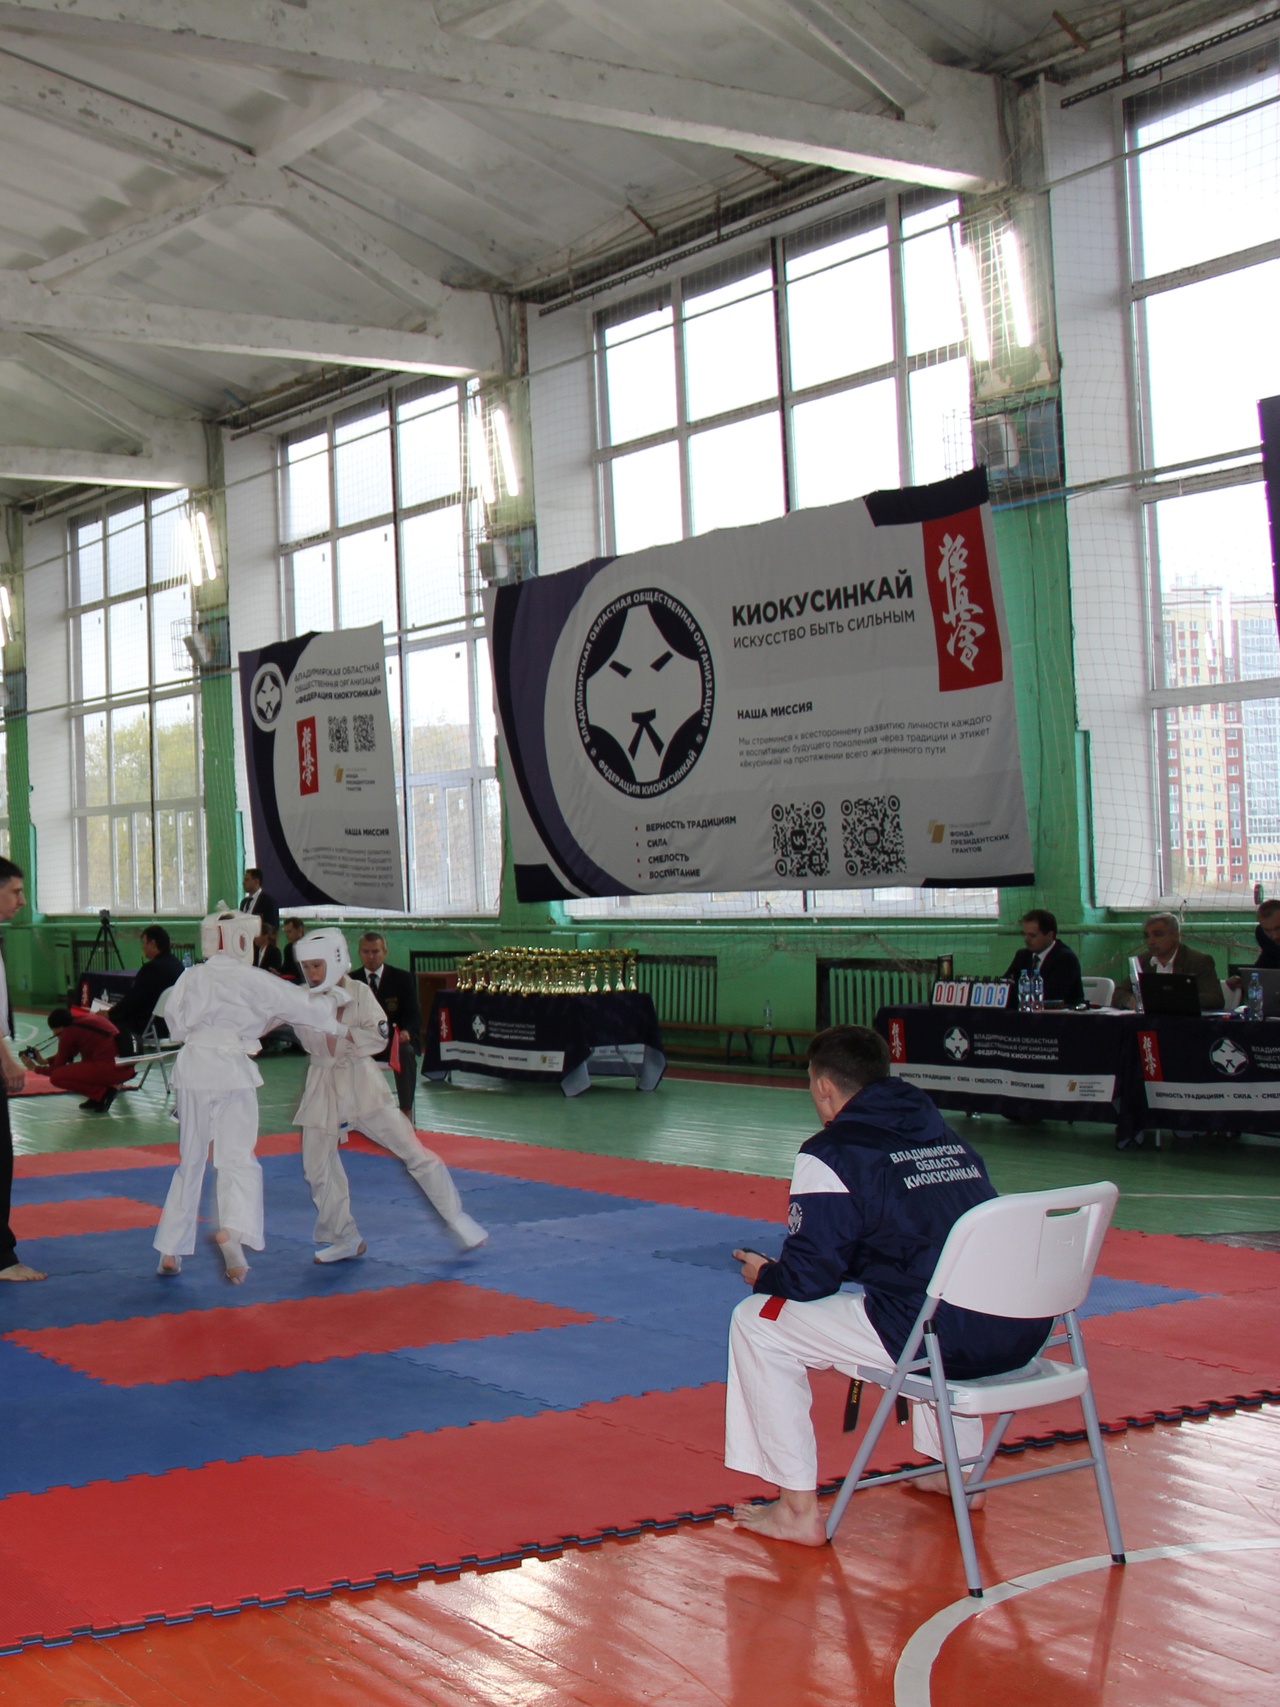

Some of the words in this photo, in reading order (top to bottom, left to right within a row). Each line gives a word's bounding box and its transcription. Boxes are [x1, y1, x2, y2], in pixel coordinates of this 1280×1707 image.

[732, 569, 913, 627] КИОКУСИНКАЙ
[733, 626, 806, 648] ИСКУССТВО
[810, 621, 844, 636] БЫТЬ
[847, 610, 915, 631] СИЛЬНЫМ
[342, 662, 380, 675] ОБЛАСТНАЯ
[576, 643, 592, 744] ВЛАДИМИРСКАЯ
[589, 595, 631, 641] ОБЛАСТНАЯ
[633, 591, 696, 632] ОБЩЕСТВЕННАЯ
[693, 631, 713, 727] ОРГАНИЗАЦИЯ
[737, 707, 768, 719] НАША
[770, 701, 813, 717] МИССИЯ
[800, 728, 862, 740] всестороннему
[863, 721, 905, 734] развитию
[907, 720, 949, 730] личности
[951, 714, 992, 727] каждого
[746, 747, 790, 757] воспитанию
[792, 741, 831, 753] будущего
[833, 736, 877, 748] поколения
[880, 734, 904, 743] через
[907, 732, 948, 743] традиции
[959, 727, 990, 739] этикет
[794, 753, 843, 765] протяжении
[845, 750, 868, 759] всего
[871, 746, 923, 757] жизненного
[925, 746, 946, 755] пути
[598, 759, 640, 794] ФЕДЕРАЦИЯ
[641, 749, 697, 794] КИОКУСИНКАЙ
[363, 828, 389, 836] МИССИЯ
[646, 820, 686, 832] ВЕРНОСТЬ
[687, 816, 737, 829] ТРАДИЦИЯМ
[647, 838, 668, 848] СИЛА
[950, 833, 1010, 845] ПРЕЗИДЕНТСКИХ
[648, 853, 689, 864] СМЕЛОСТЬ
[951, 846, 982, 854] ГРАНТОВ
[649, 868, 700, 879] ВОСПИТАНИЕ
[935, 984, 965, 1004] 001
[973, 986, 1007, 1006] 003
[889, 1144, 967, 1164] ВЛАДИМИРСКАЯ
[915, 1157, 960, 1171] ОБЛАСТЬ
[903, 1164, 982, 1189] КИОКУСИНКАЙ
